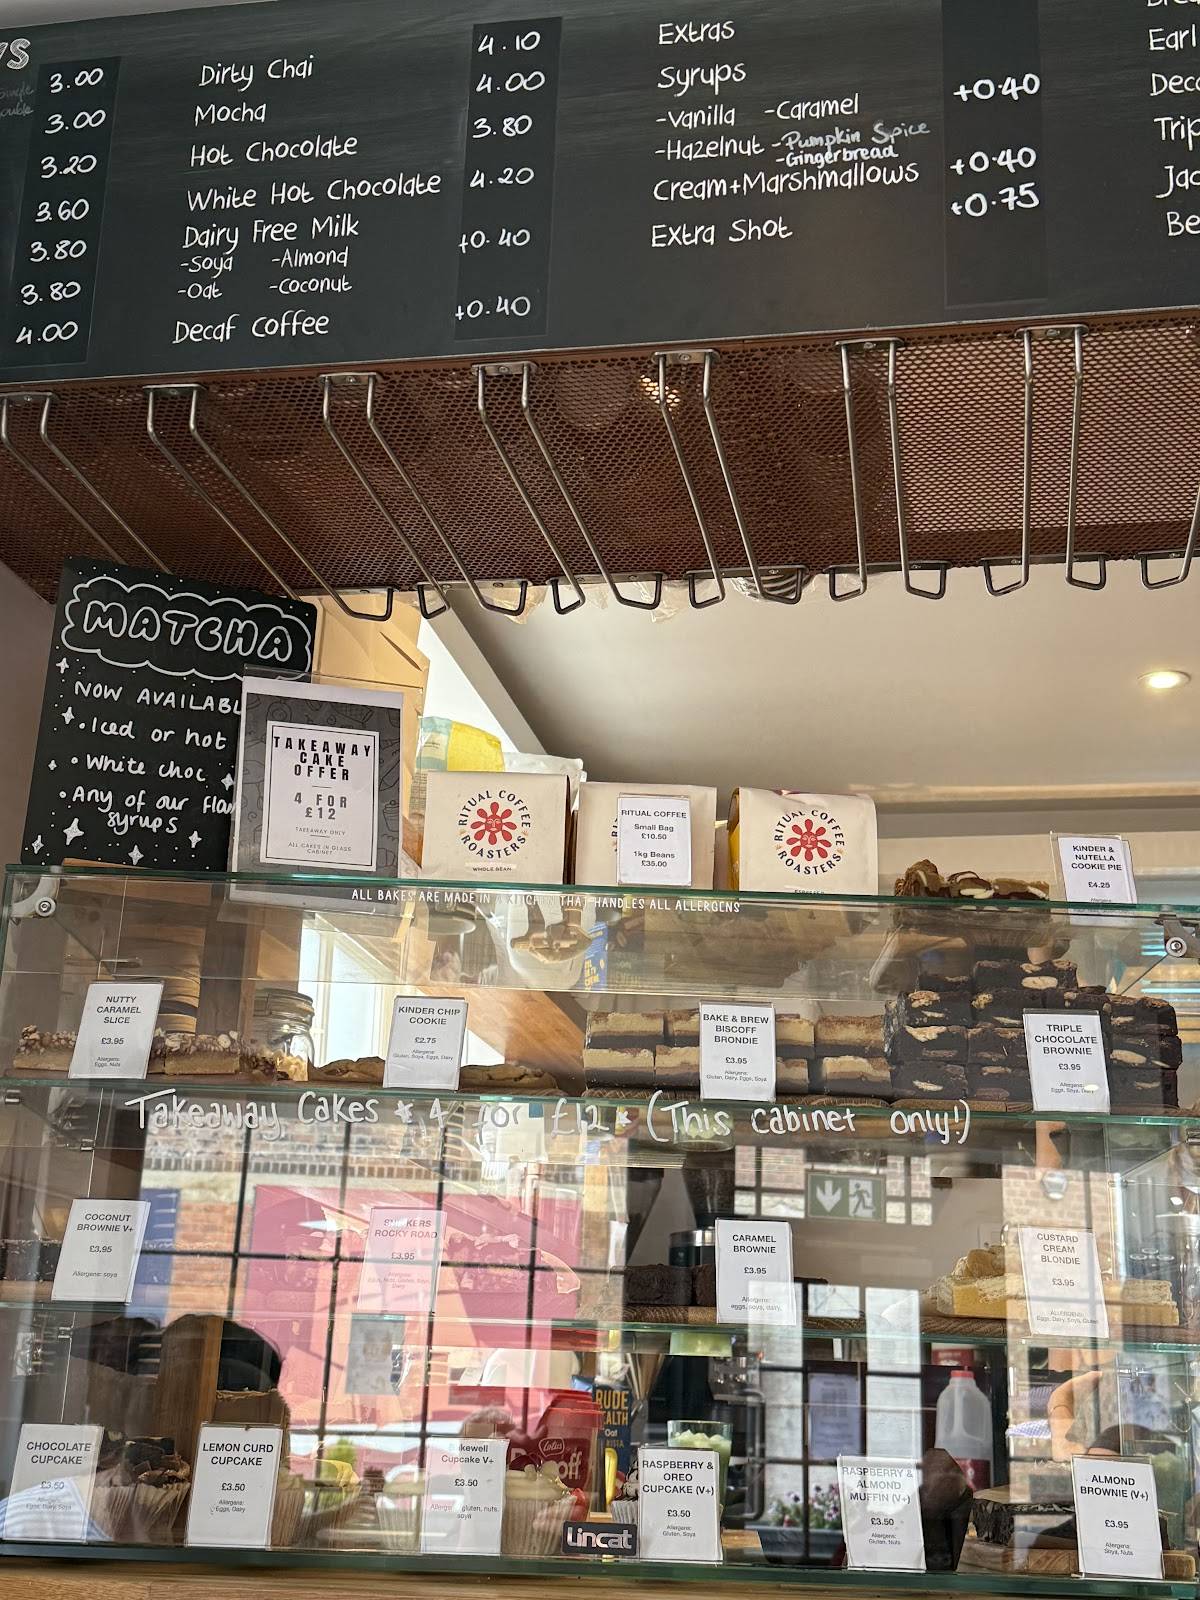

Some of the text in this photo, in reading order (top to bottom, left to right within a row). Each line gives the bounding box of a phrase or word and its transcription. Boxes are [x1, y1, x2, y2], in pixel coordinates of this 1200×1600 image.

[659, 19, 735, 45] Extras
[1149, 23, 1197, 50] Earl
[478, 31, 541, 55] 4.10
[50, 68, 104, 93] 3.00
[200, 59, 313, 91] Dirty Chai
[476, 70, 545, 93] 4.00
[657, 62, 746, 97] Syrups
[194, 103, 266, 126] Mocha
[656, 93, 859, 128] -Vanilla -Caramel
[45, 110, 106, 134] 3.00
[472, 115, 533, 138] 3.80
[655, 135, 764, 162] -Hazelnut
[872, 121, 931, 144] Spice
[190, 136, 358, 167] Hot Chocolate
[41, 155, 97, 178] 3.20
[470, 167, 534, 189] 4.20
[653, 161, 919, 201] Cream+Marshmallows
[187, 173, 442, 211] White Hot Chocolate
[36, 200, 89, 222] 3.60
[183, 215, 359, 256] Dairy Free Milk
[651, 216, 793, 248] Extra Shot
[459, 228, 530, 254] +0.40
[30, 240, 87, 262] 3.80
[181, 247, 348, 278] -Soya -Almond
[21, 281, 80, 305] 3.80
[178, 281, 222, 300] -Oat
[456, 296, 531, 321] +0.40
[17, 321, 78, 345] 4.00
[172, 309, 330, 345] Decaf Coffee
[83, 600, 292, 661] MATCHA
[75, 681, 122, 701] NOW
[92, 717, 226, 750] Iced or hot
[273, 735, 371, 757] TAKEAWAY
[300, 751, 344, 768] CAKE
[87, 754, 206, 782] White choc
[294, 764, 349, 781] OFFER
[72, 785, 189, 813] Any of our
[294, 791, 347, 808] 4 FOR
[305, 806, 336, 820] £12
[458, 790, 493, 827] RITUAL
[498, 789, 531, 829] COFFEE
[621, 809, 687, 819] RITUAL COFFEE
[107, 811, 178, 836] syrups
[634, 823, 674, 832] Small Bag
[774, 809, 845, 847] RITUAL COFFEE
[460, 834, 527, 859] ROASTERS
[1072, 845, 1106, 853] KINDER
[633, 850, 675, 859] 1kg Beans
[1075, 854, 1116, 862] NUTELLA
[641, 860, 667, 868] £35.00
[778, 850, 841, 875] ROASTERS
[1071, 862, 1106, 870] COOKIE
[351, 889, 476, 904] ALL BAKES ARE MADE
[594, 897, 645, 910] HANDLES
[649, 899, 671, 911] ALL
[675, 898, 741, 913] ALLERGENS
[96, 1006, 142, 1014] CARAMEL
[398, 1006, 435, 1015] KINDER
[103, 1016, 131, 1024] SLICE
[409, 1016, 447, 1025] COOKIE
[703, 1013, 729, 1022] BAKE
[740, 1015, 769, 1024] BREW
[715, 1025, 757, 1034] BISCOFF
[1046, 1024, 1083, 1033] TRIPLE
[101, 1037, 125, 1045] £3.95
[414, 1036, 437, 1044] £2.75
[714, 1035, 759, 1045] BRONDIE
[1034, 1035, 1098, 1044] CHOCOLATE
[1043, 1046, 1093, 1055] BROWNIE
[1058, 1063, 1081, 1071] £3.95
[125, 1088, 282, 1141] Takeaway
[299, 1090, 381, 1125] Cakes
[646, 1089, 731, 1145] (This
[750, 1104, 857, 1136] cabinet
[85, 1213, 132, 1222] COCONUT
[76, 1223, 121, 1232] BROWNIE
[732, 1234, 777, 1243] CARAMEL
[1036, 1233, 1079, 1243] CUSTARD
[89, 1245, 113, 1253] £3.95
[733, 1245, 777, 1254] BROWNIE
[1042, 1244, 1075, 1253] CREAM
[1040, 1255, 1081, 1265] BLONDIE
[744, 1266, 767, 1275] £3.95
[26, 1441, 92, 1452] CHOCOLATE
[202, 1443, 274, 1453] LEMON CURD
[31, 1454, 83, 1465] CUPCAKE
[210, 1456, 264, 1466] CUPCAKE
[441, 1454, 480, 1464] Cupcake
[642, 1460, 714, 1470] RASPBERRY &
[454, 1478, 478, 1487] £3.50
[663, 1473, 693, 1482] OREO
[856, 1480, 902, 1490] ALMOND
[1091, 1474, 1136, 1486] ALMOND
[221, 1482, 246, 1491] £3.50
[642, 1484, 714, 1496] CUPCAKE (V+)
[1080, 1486, 1149, 1502] BROWNIE (V+)
[850, 1491, 889, 1502] MUFFIN
[667, 1509, 691, 1518] £3.50
[870, 1517, 894, 1526] £3.50
[1104, 1519, 1129, 1529] £3.95
[566, 1526, 633, 1549] Lincat
